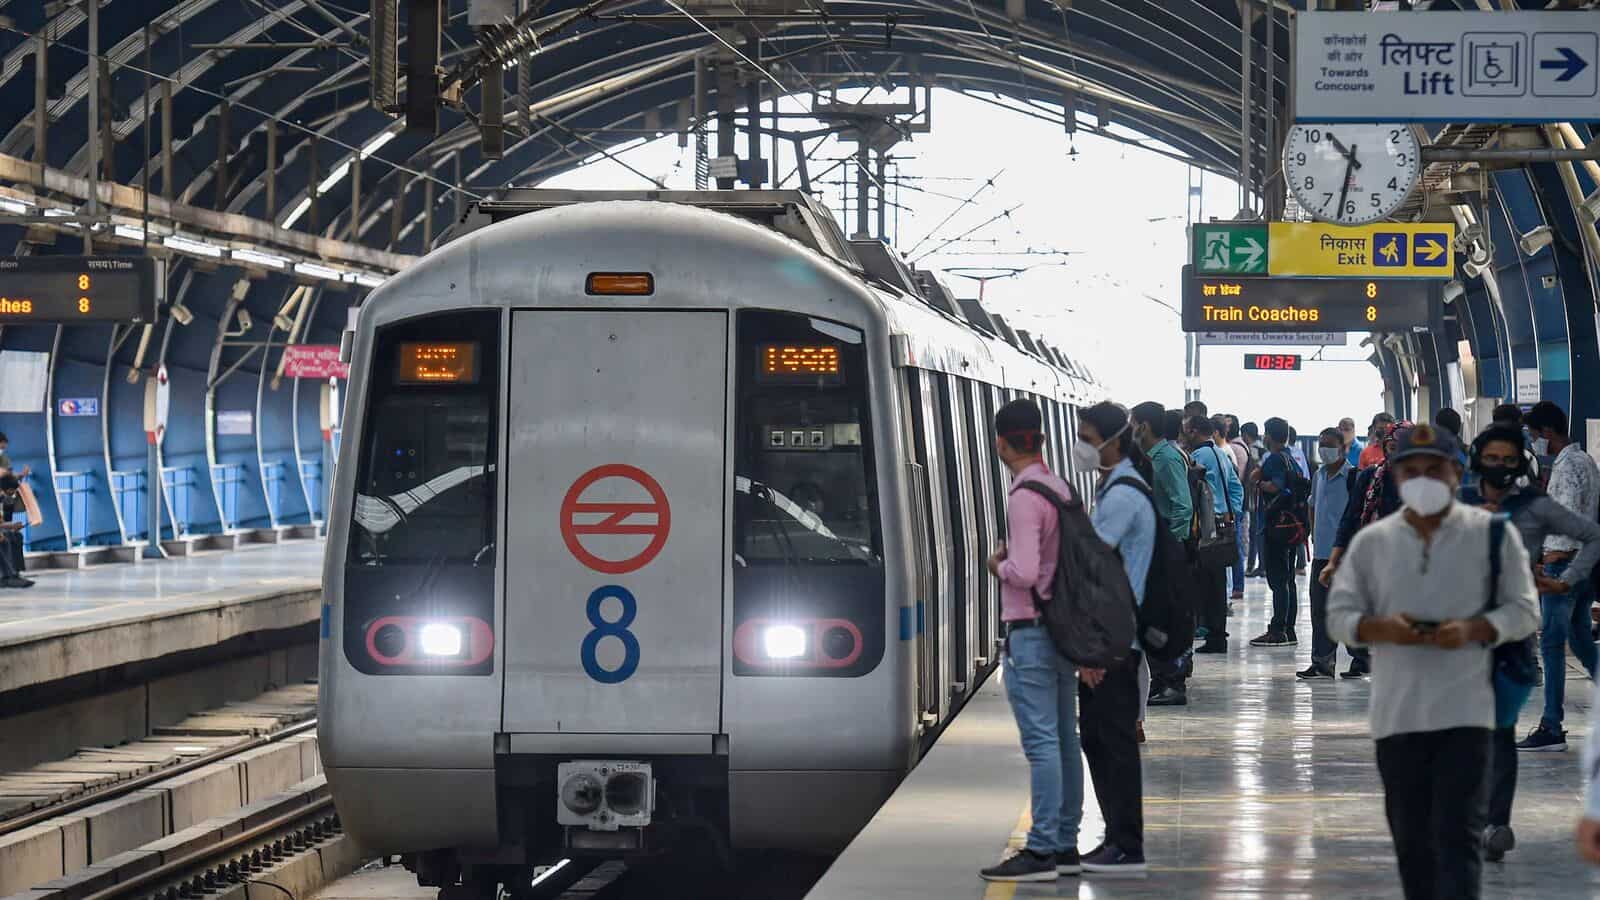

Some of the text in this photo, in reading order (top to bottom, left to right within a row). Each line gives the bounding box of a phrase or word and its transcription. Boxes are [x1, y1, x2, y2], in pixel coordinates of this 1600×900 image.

[1379, 33, 1455, 66] लिफ्ट
[1320, 67, 1368, 77] Towards
[1315, 80, 1375, 91] Concourse
[1404, 71, 1454, 95] Lift
[1304, 129, 1321, 144] 10
[1390, 130, 1400, 144] 2
[1296, 152, 1306, 166] 9
[1396, 153, 1407, 167] 3
[1304, 176, 1314, 190] 8
[1387, 176, 1398, 191] 4
[1322, 192, 1333, 207] 7
[1371, 193, 1381, 207] 5
[1345, 200, 1355, 214] 6
[1320, 233, 1367, 251] निकास
[1338, 253, 1367, 265] Exit
[78, 274, 89, 290] 8
[1366, 283, 1377, 298] 8
[0, 297, 89, 313] hes 8
[1203, 306, 1377, 321] Train Coaches 8
[1224, 331, 1260, 341] Towards
[1262, 331, 1294, 341] Dwarka
[1296, 331, 1323, 341] Sector
[1255, 355, 1296, 369] 10:32
[581, 585, 641, 684] 8
